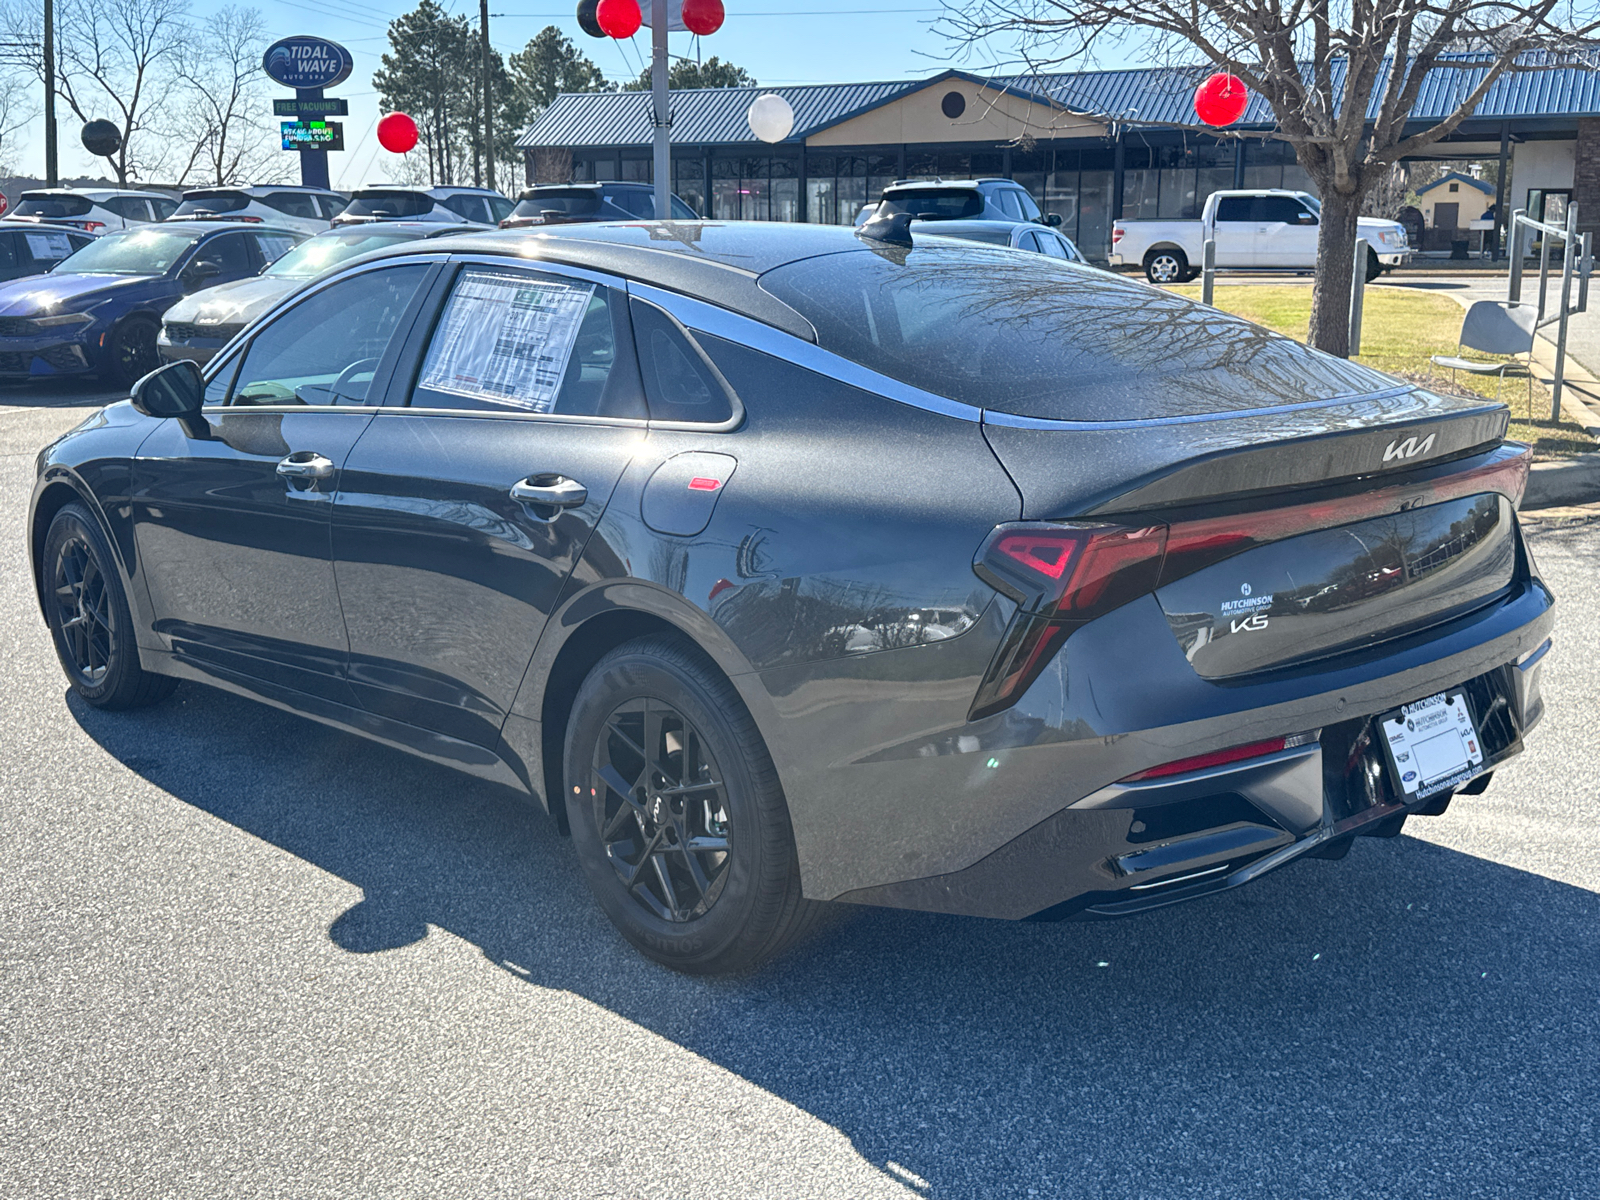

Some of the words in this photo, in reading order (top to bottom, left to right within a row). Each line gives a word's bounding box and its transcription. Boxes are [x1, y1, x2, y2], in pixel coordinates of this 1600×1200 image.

[291, 46, 328, 59] TIDAL
[297, 60, 337, 72] WAVE
[276, 102, 297, 112] FREE
[299, 101, 337, 111] VACUUMS
[1382, 433, 1436, 462] KIA
[1221, 595, 1274, 611] HUTCHINSON
[1222, 607, 1255, 617] AUTOMOTIVE
[1255, 603, 1272, 612] GROUP
[1230, 614, 1269, 633] K5
[1408, 692, 1447, 715] HUTCHINSON
